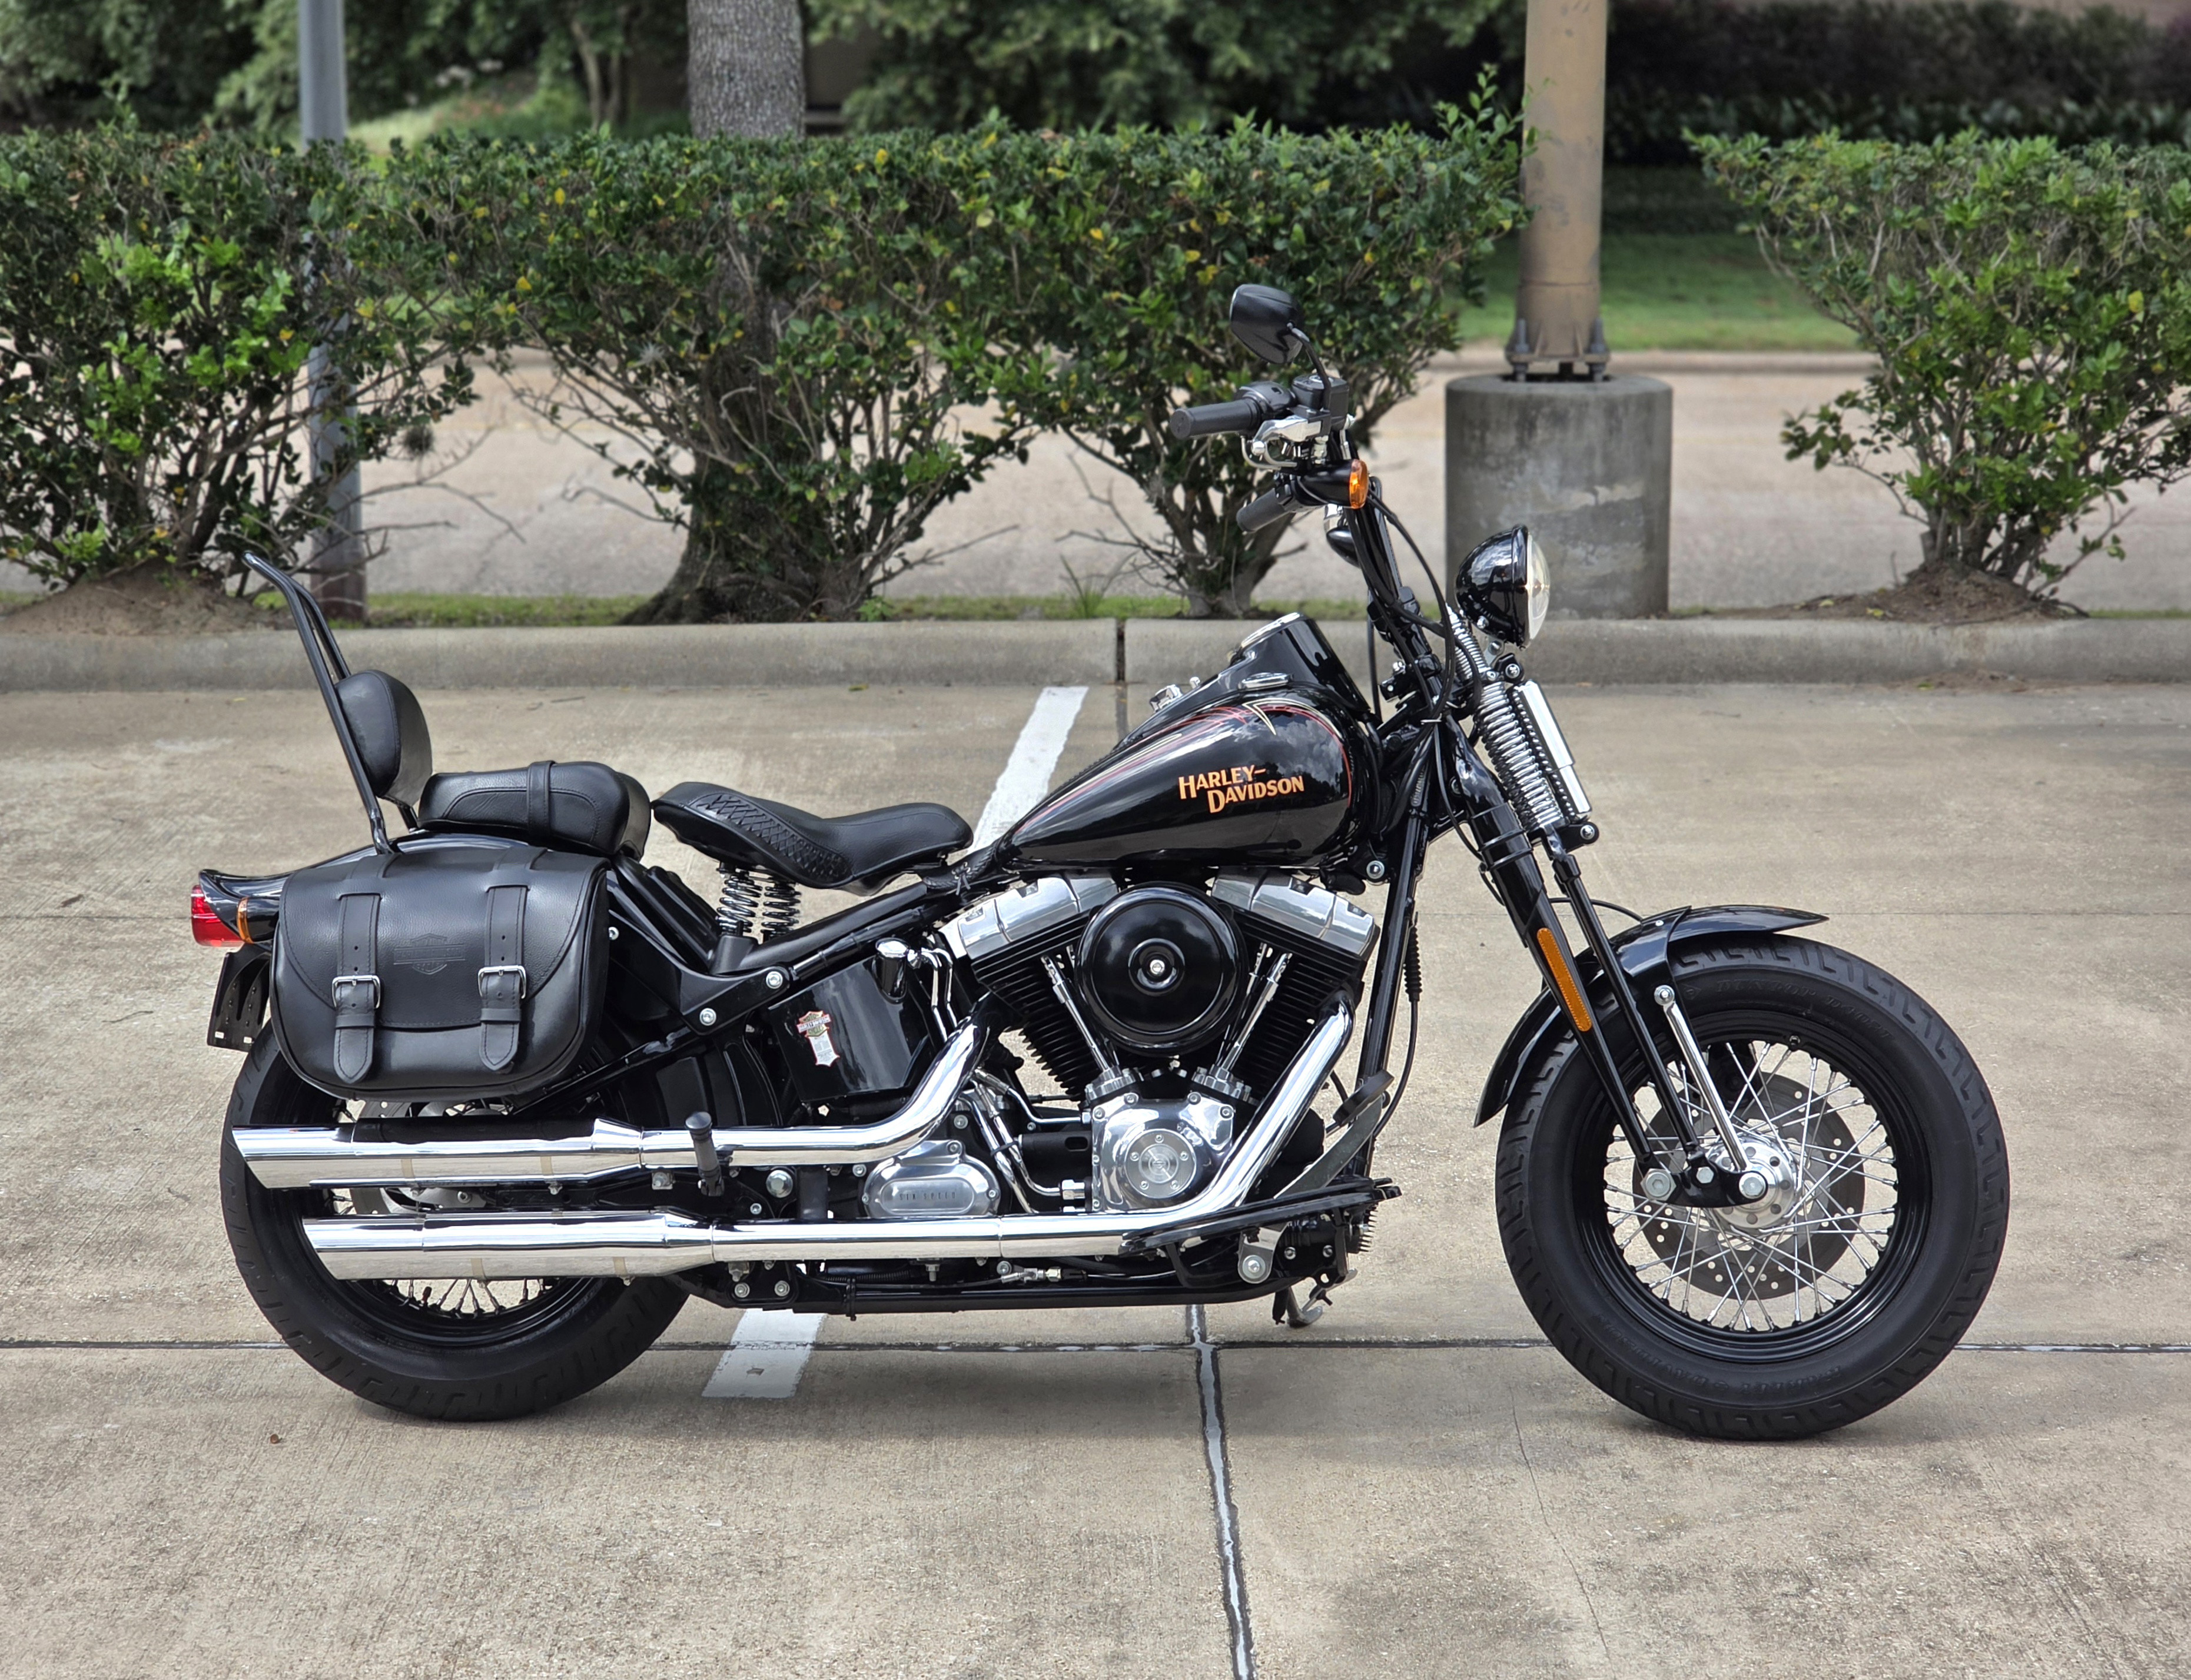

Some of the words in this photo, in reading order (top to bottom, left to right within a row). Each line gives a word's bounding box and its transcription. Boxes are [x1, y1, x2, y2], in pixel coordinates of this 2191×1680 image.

[1179, 765, 1266, 799] HARLEY-
[1207, 775, 1304, 814] DAVIDSON
[924, 1191, 955, 1200] SPEED
